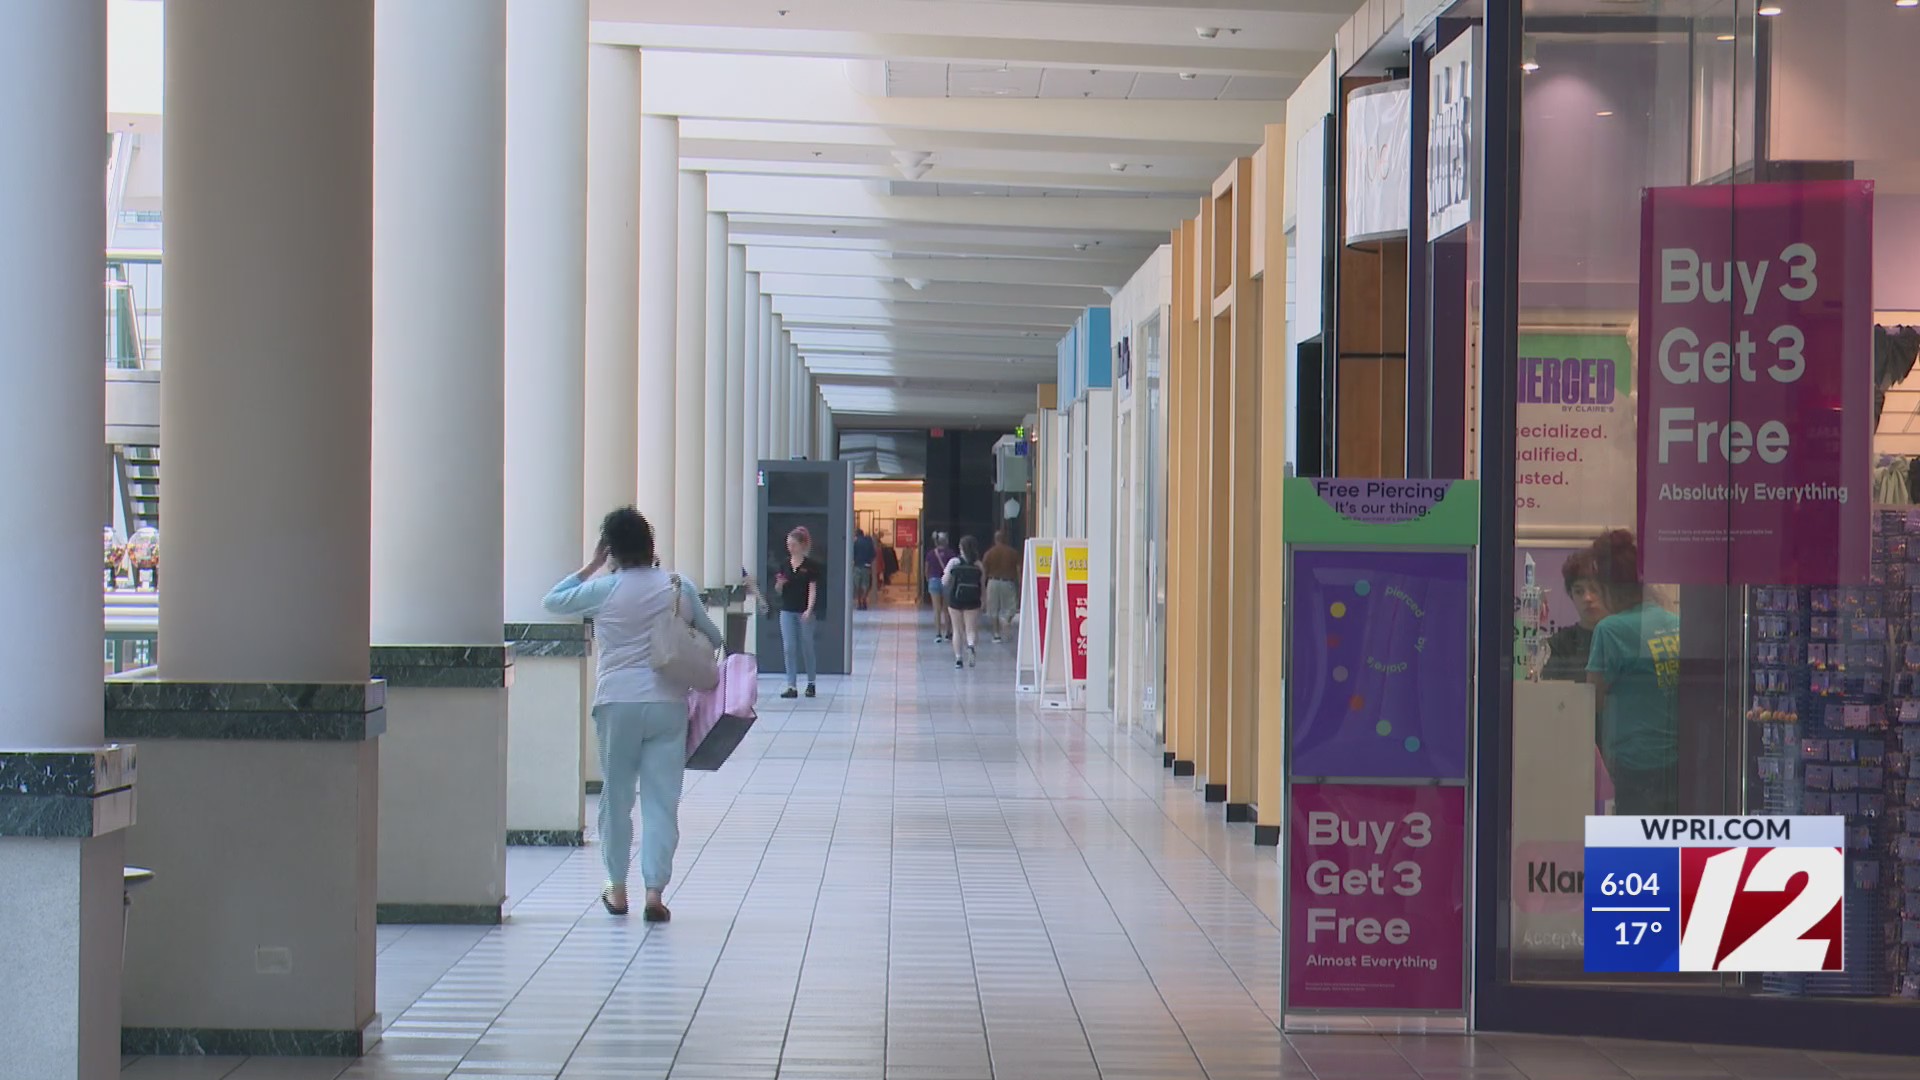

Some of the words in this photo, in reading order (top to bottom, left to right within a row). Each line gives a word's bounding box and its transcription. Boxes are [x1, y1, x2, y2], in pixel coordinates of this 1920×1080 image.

[1660, 248, 1769, 314] Buy
[1779, 243, 1818, 302] 3
[1658, 327, 1756, 384] Get
[1767, 325, 1806, 383] 3
[1516, 424, 1607, 439] ecialized.
[1658, 407, 1790, 464] Free
[1317, 482, 1359, 497] Free
[1658, 483, 1749, 505] Absolutely
[1754, 482, 1848, 504] Everything
[1335, 502, 1357, 513] It's
[1361, 504, 1385, 514] our
[1390, 502, 1431, 517] thing.
[1385, 586, 1425, 618] pierced
[1308, 811, 1394, 854] Buy
[1402, 812, 1432, 848] 3
[1306, 860, 1384, 896] Get
[1393, 860, 1422, 897] 3
[1307, 907, 1411, 945] Free
[1306, 955, 1357, 967] Almost
[1361, 955, 1438, 971] Everything
